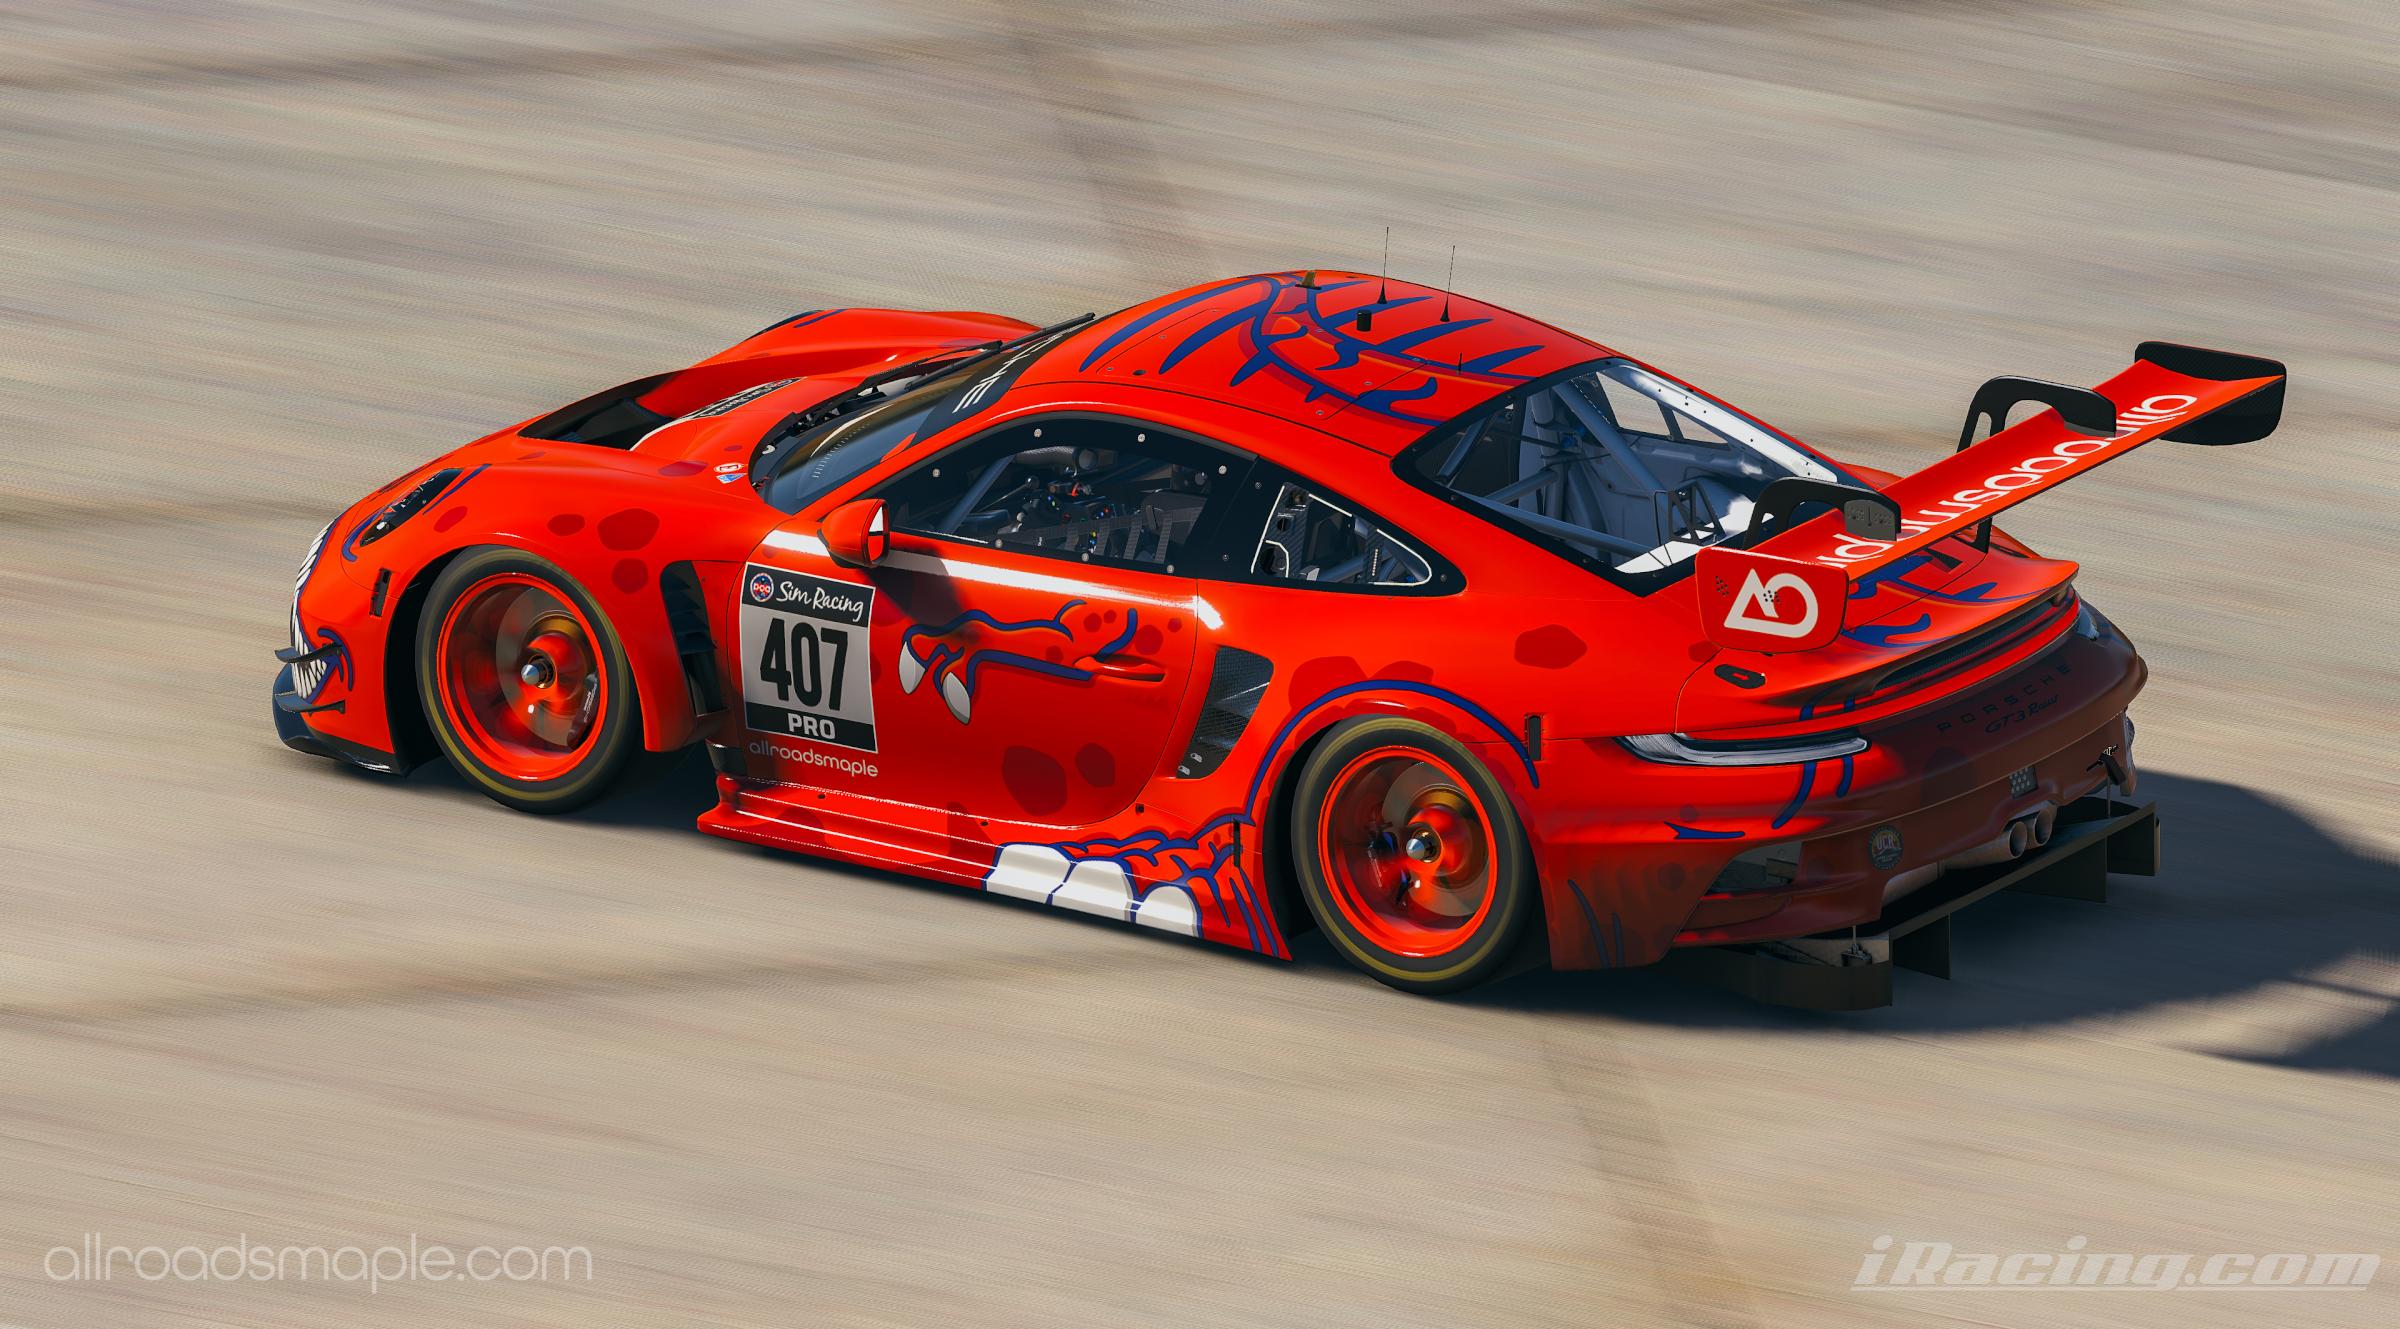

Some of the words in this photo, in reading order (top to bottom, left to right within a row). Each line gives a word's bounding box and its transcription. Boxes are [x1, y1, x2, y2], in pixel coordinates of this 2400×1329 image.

[776, 581, 811, 605] Sim
[812, 587, 864, 622] Racing
[760, 617, 848, 711] 407
[1936, 663, 2072, 732] PORSCHE
[787, 712, 836, 740] PRO
[749, 740, 879, 778] allroadsmaple
